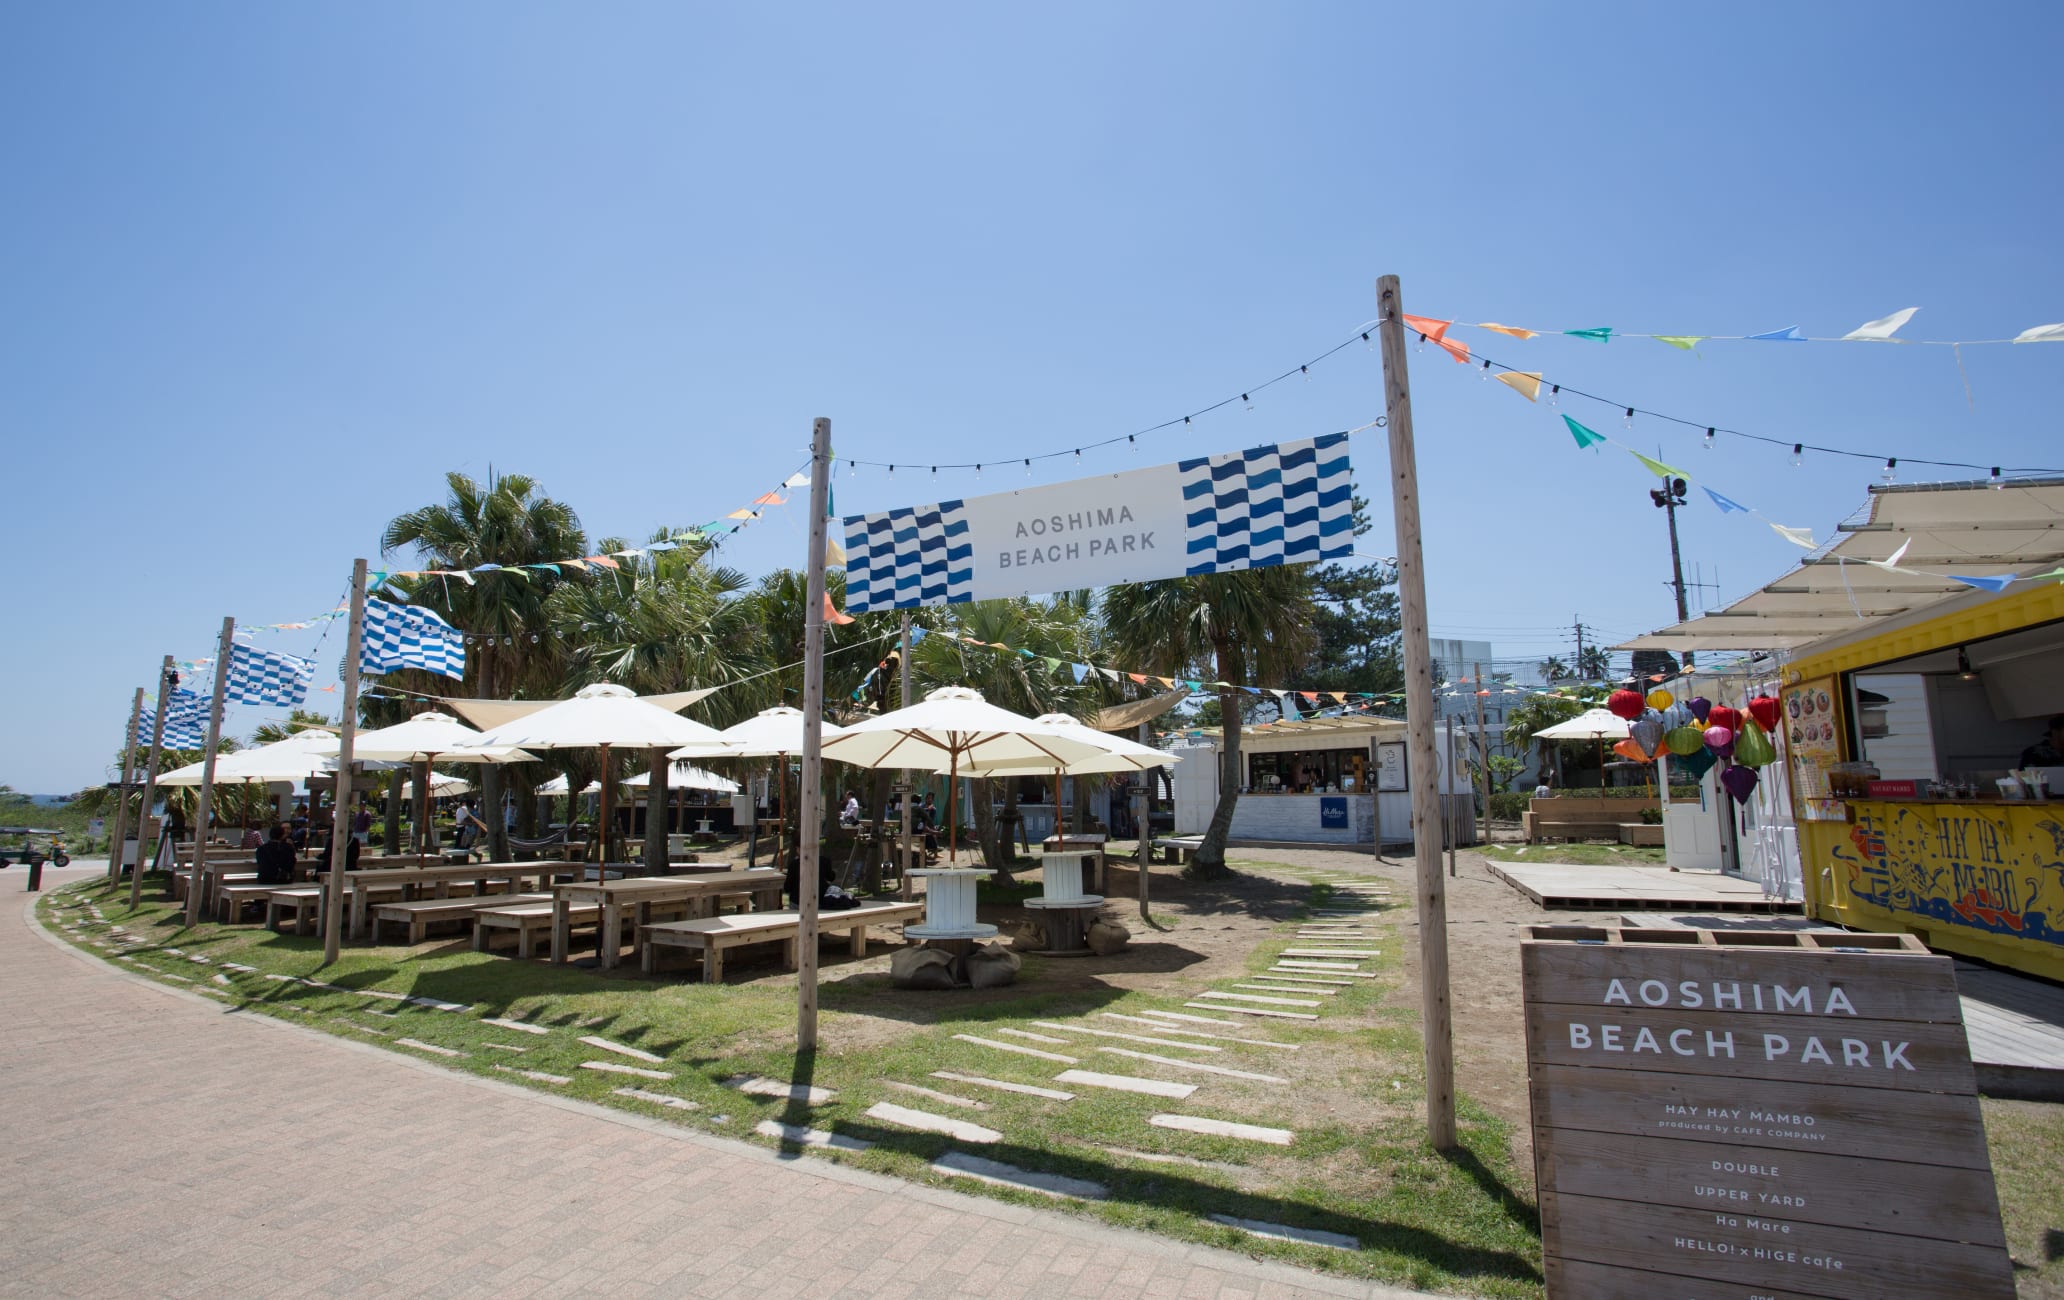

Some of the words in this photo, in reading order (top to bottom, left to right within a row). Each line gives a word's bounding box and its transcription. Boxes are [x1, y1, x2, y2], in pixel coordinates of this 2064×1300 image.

[1015, 505, 1135, 539] AOSHIMA
[999, 542, 1080, 569] BEACH
[1089, 532, 1155, 558] PARK
[1603, 978, 1858, 1015] AOSHIMA
[1569, 1023, 1735, 1058] BEACH
[1763, 1033, 1916, 1071] PARK
[1665, 1104, 1698, 1116] HAY
[1707, 1107, 1741, 1120] HAY
[1750, 1111, 1815, 1126] MAMBO
[1658, 1120, 1711, 1131] produced
[1715, 1124, 1729, 1135] by
[1733, 1126, 1762, 1136] CAFE
[1767, 1129, 1826, 1141] COMPANY
[1712, 1160, 1780, 1177] DOUBLE
[1694, 1185, 1749, 1201] UPPER
[1758, 1192, 1806, 1207] YARD
[1716, 1215, 1738, 1227] Ha
[1747, 1218, 1791, 1234] Mare
[1675, 1237, 1735, 1255] HELLO!
[1754, 1247, 1796, 1263] HIGE
[1802, 1256, 1843, 1270] cafe
